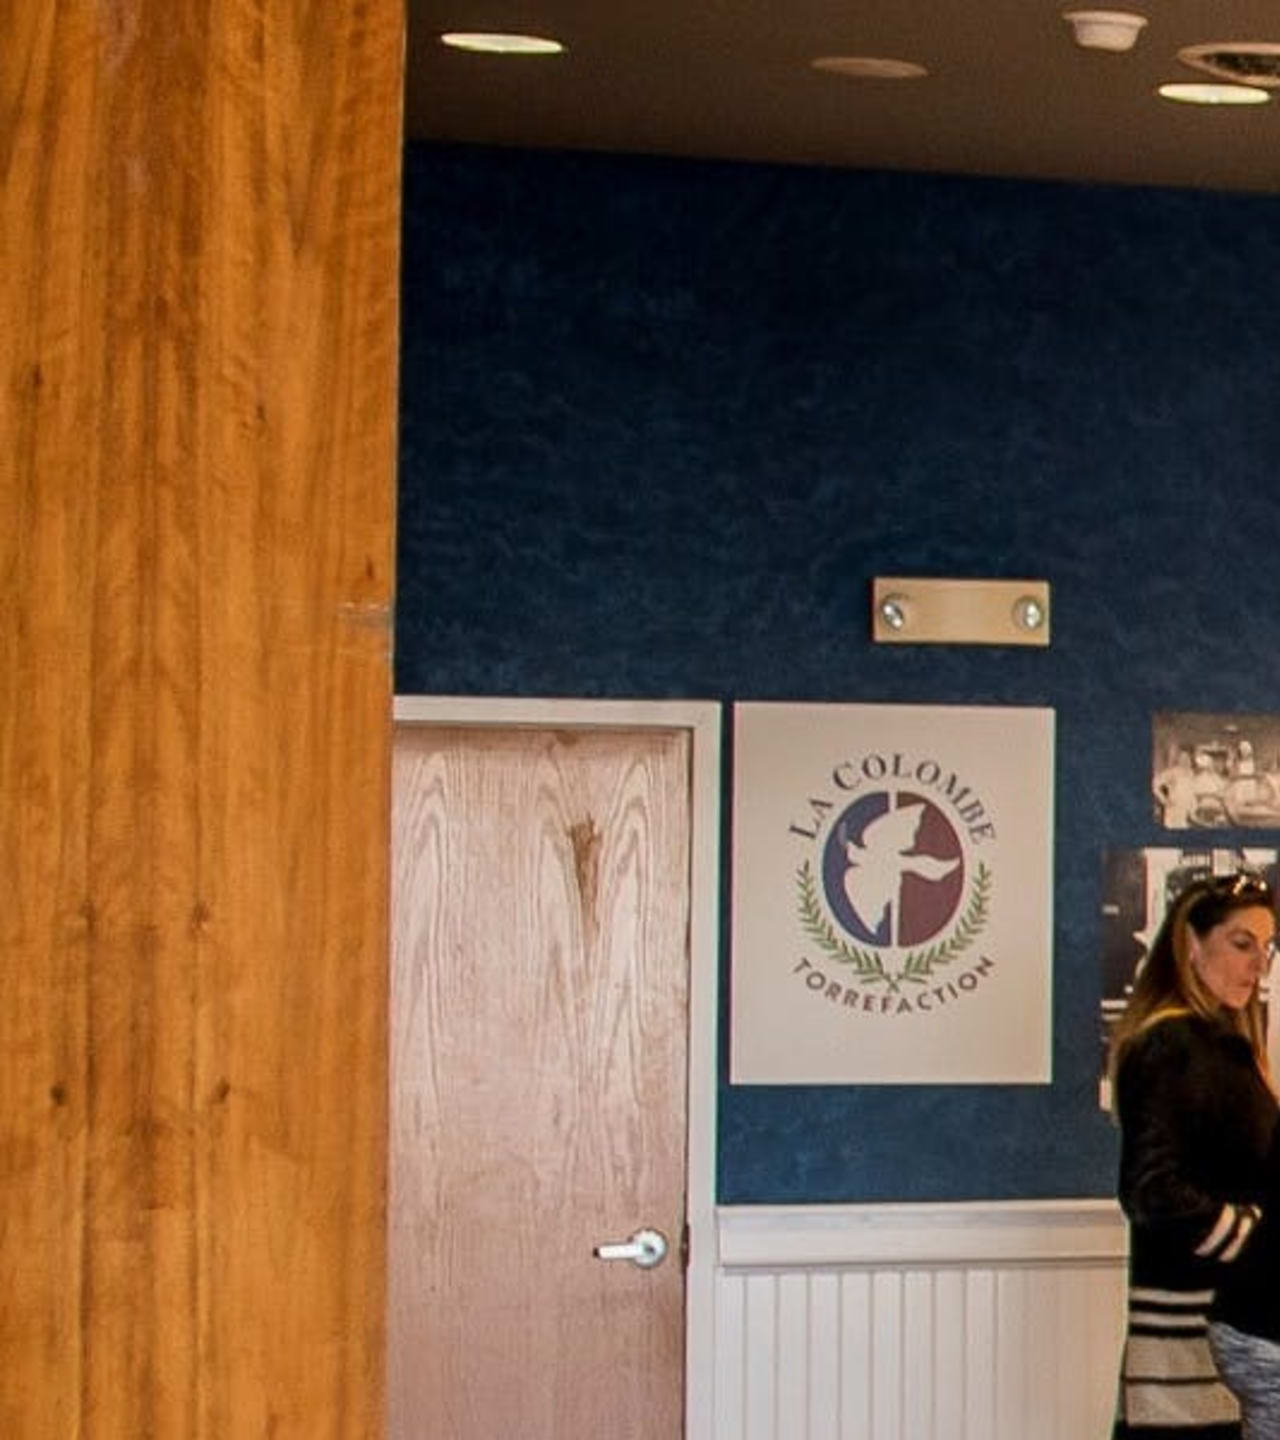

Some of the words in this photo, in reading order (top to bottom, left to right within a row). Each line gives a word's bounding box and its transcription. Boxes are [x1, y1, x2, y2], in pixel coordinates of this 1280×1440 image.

[788, 795, 834, 840] LA
[832, 753, 996, 845] COLOMBE
[792, 957, 996, 1014] TORREFACTION
